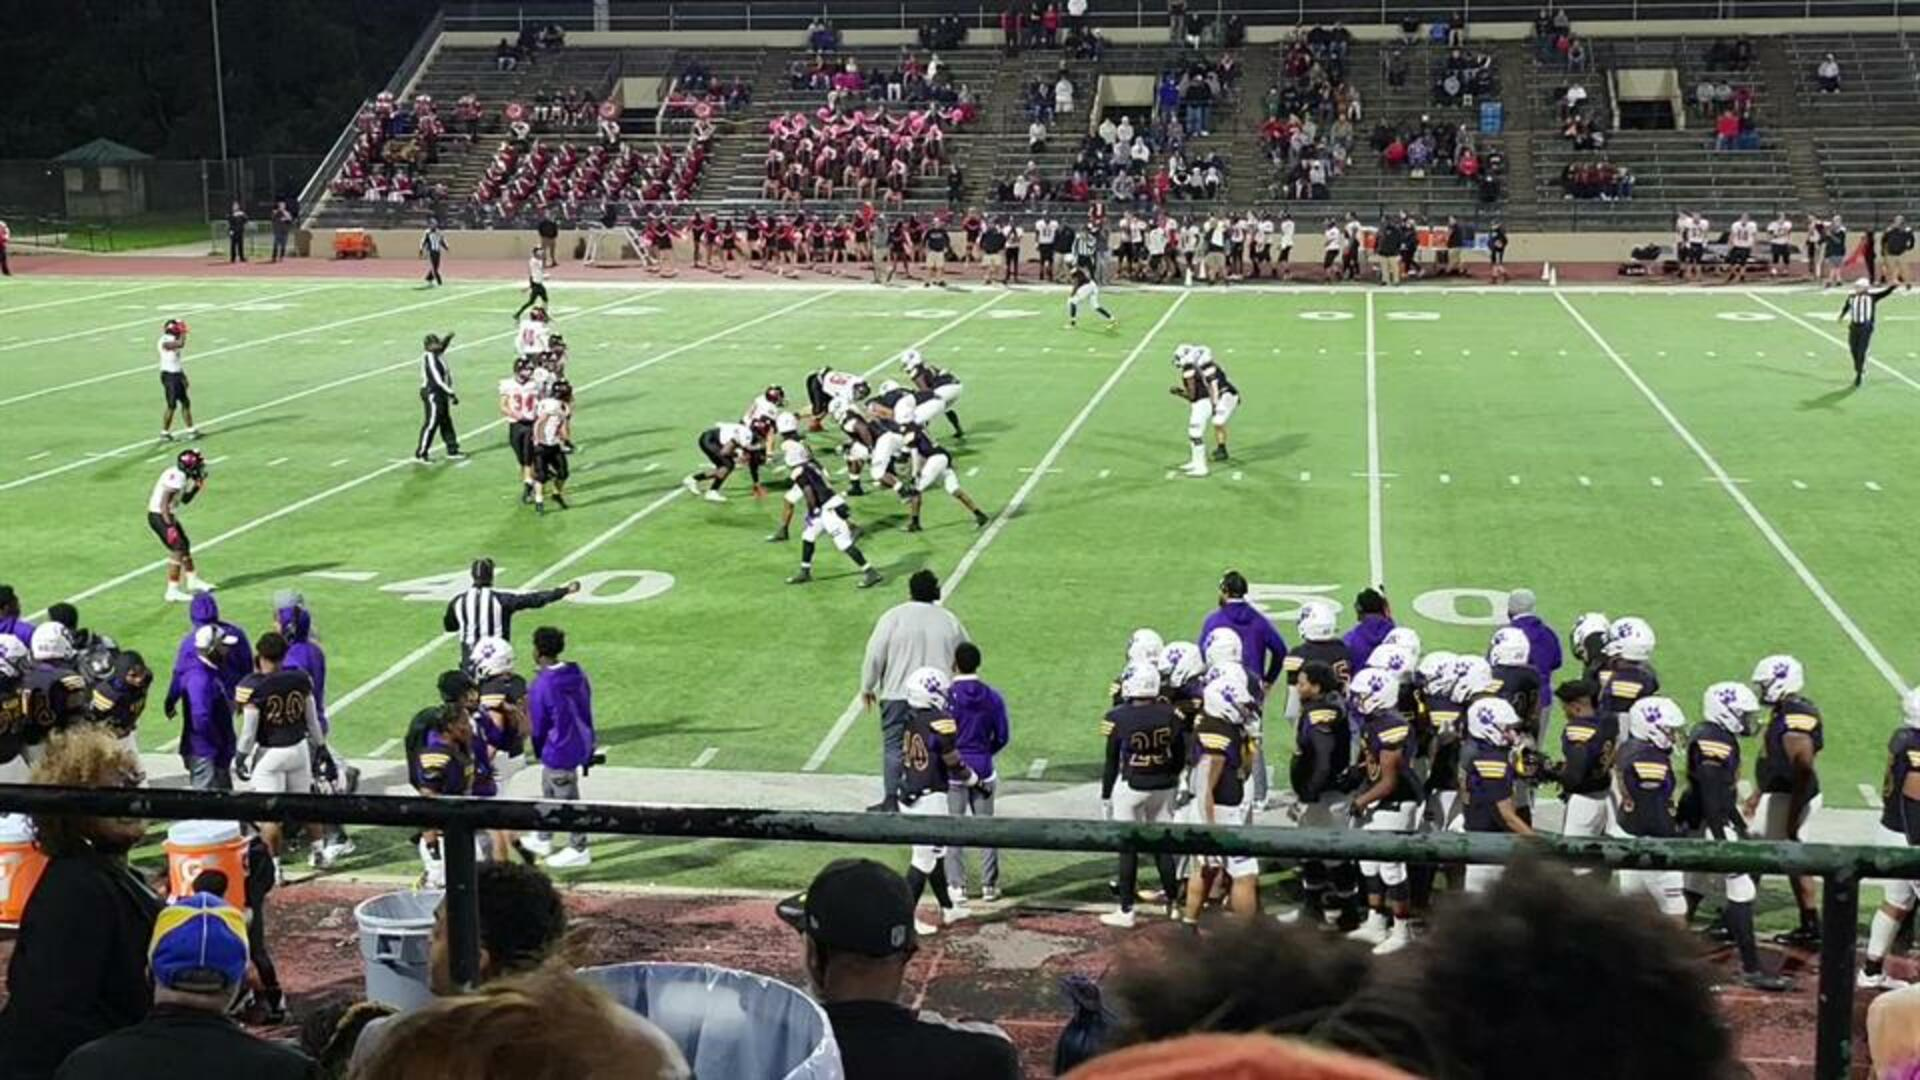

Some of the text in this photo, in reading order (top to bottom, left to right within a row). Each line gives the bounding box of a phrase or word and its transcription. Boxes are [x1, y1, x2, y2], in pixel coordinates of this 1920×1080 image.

[513, 393, 537, 412] 34
[266, 694, 305, 724] 20
[1129, 726, 1172, 767] 25
